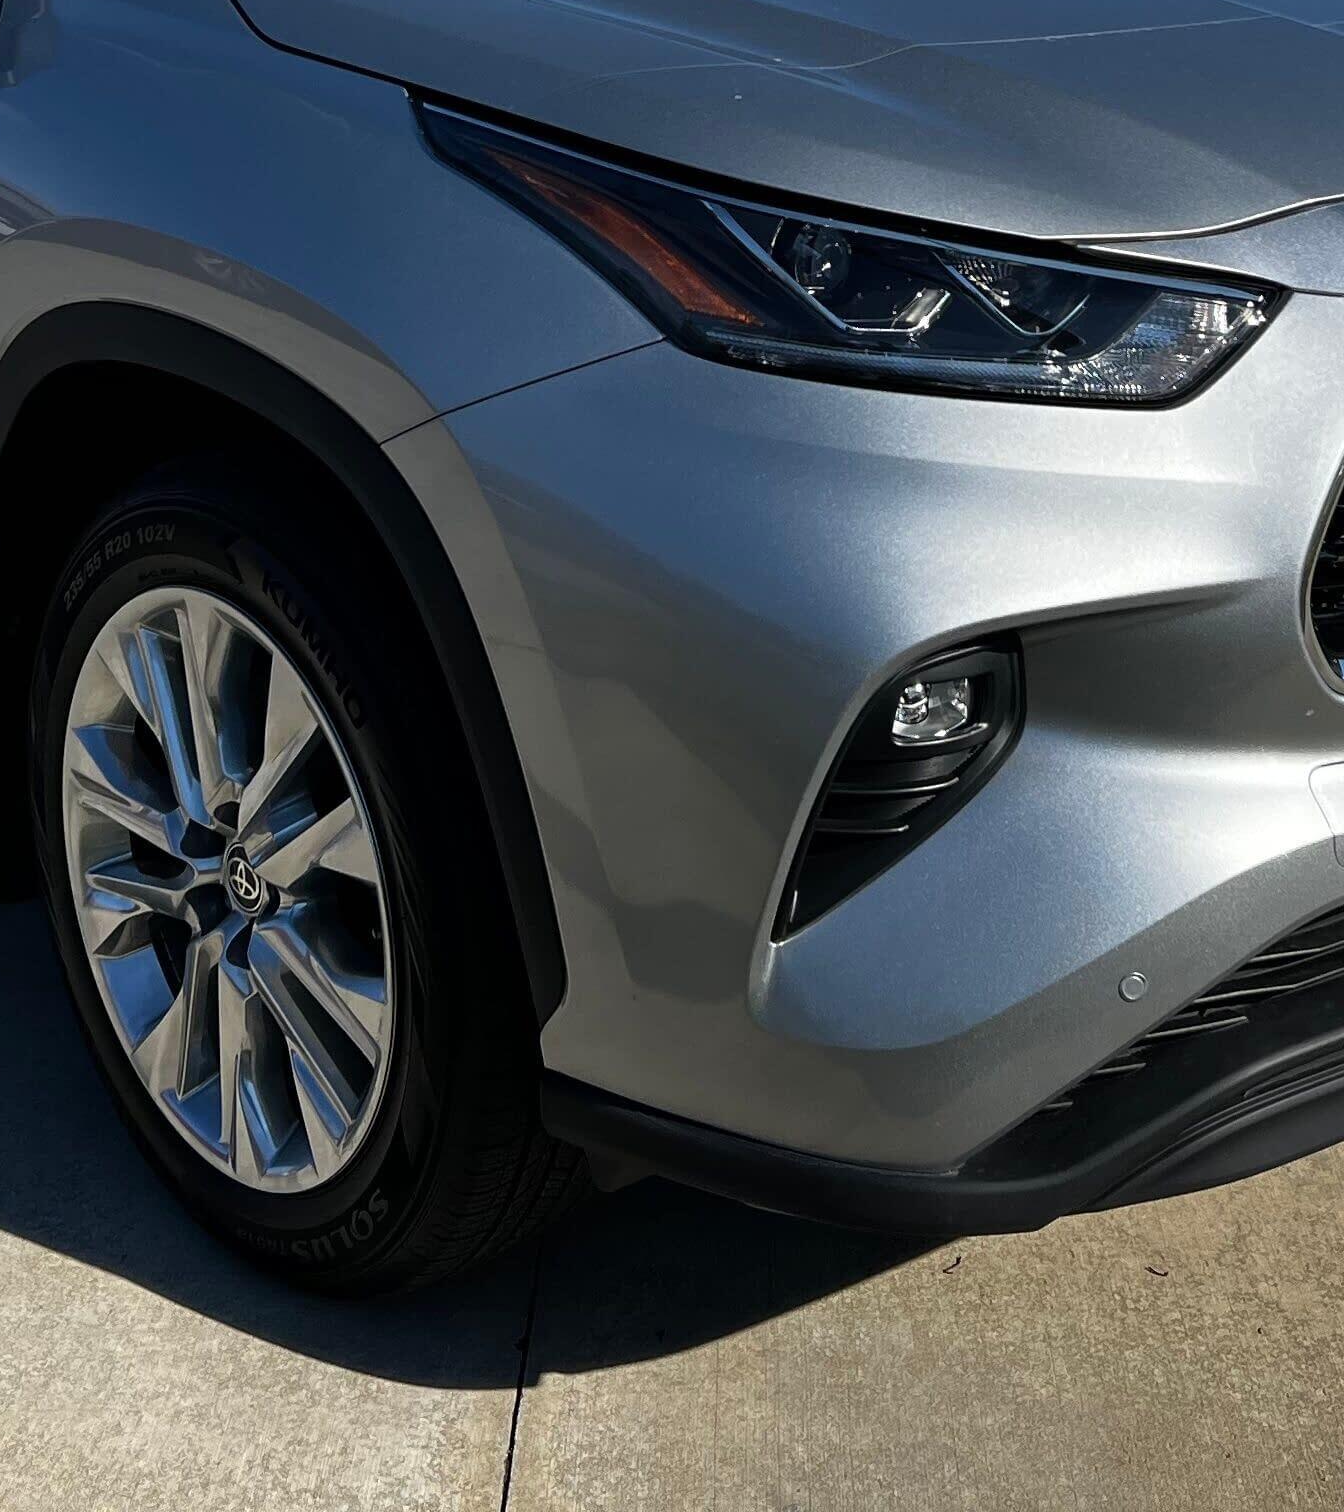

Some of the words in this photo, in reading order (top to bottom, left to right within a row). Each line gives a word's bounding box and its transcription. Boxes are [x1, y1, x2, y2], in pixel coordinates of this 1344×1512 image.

[104, 531, 132, 560] R20
[136, 523, 176, 545] 102V
[290, 1187, 389, 1263] SOLUS
